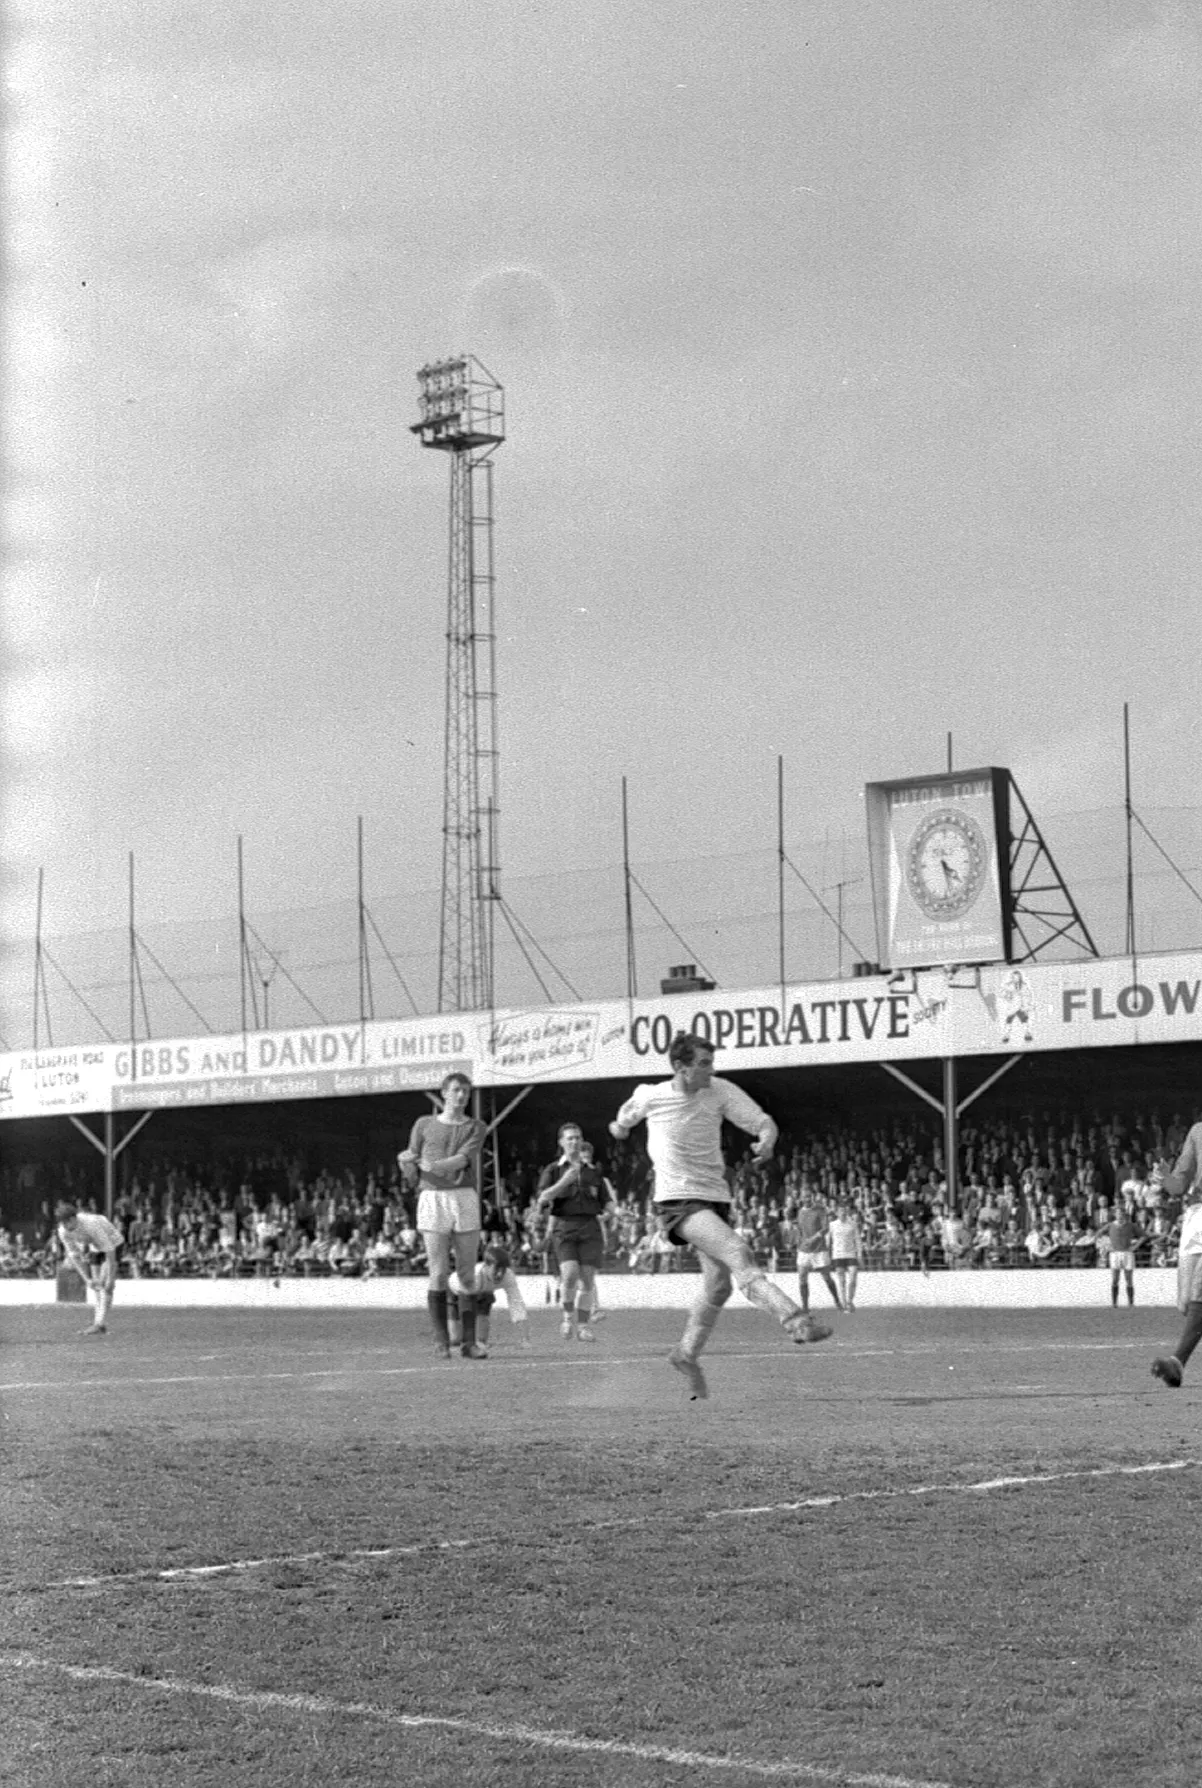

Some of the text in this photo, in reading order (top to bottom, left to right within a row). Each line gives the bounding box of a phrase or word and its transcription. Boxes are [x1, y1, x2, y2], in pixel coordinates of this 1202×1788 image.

[115, 1032, 465, 1077] GIBBS AND DANDY LIMITED
